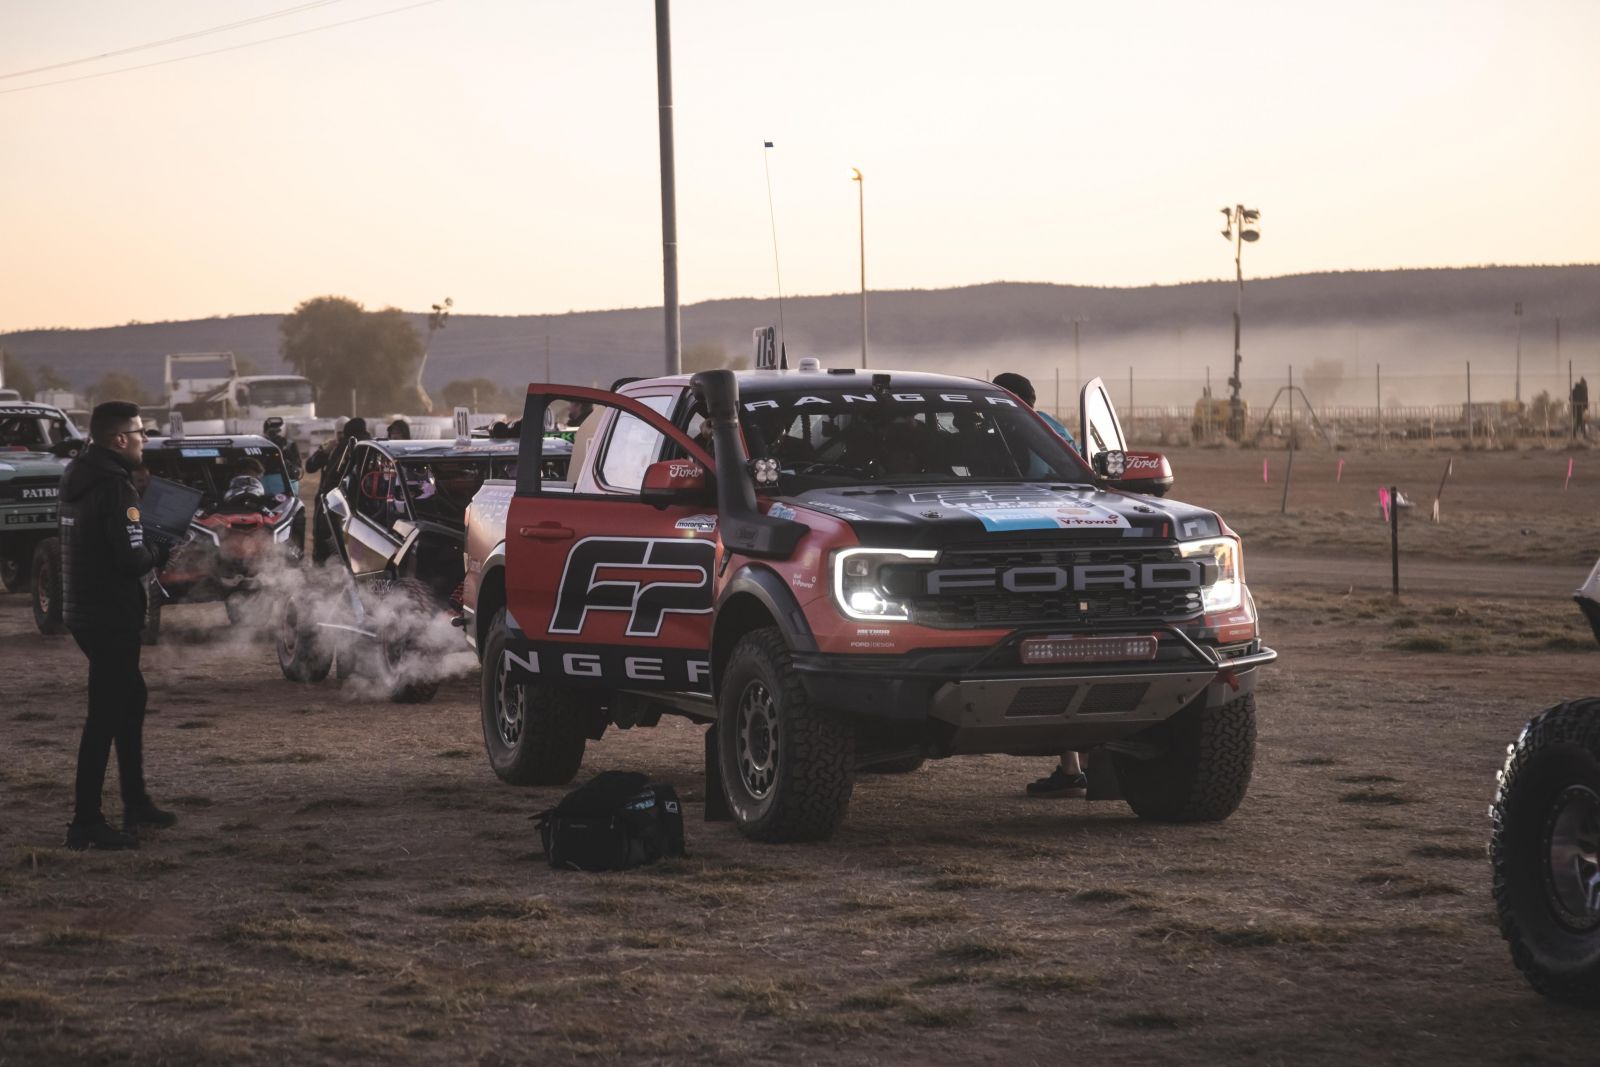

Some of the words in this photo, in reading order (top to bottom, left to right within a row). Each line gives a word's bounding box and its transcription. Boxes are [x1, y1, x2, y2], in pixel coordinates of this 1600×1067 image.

[744, 393, 1019, 412] RANGER
[1126, 455, 1159, 469] Ford
[669, 464, 702, 478] Ford
[927, 561, 1200, 595] FORD
